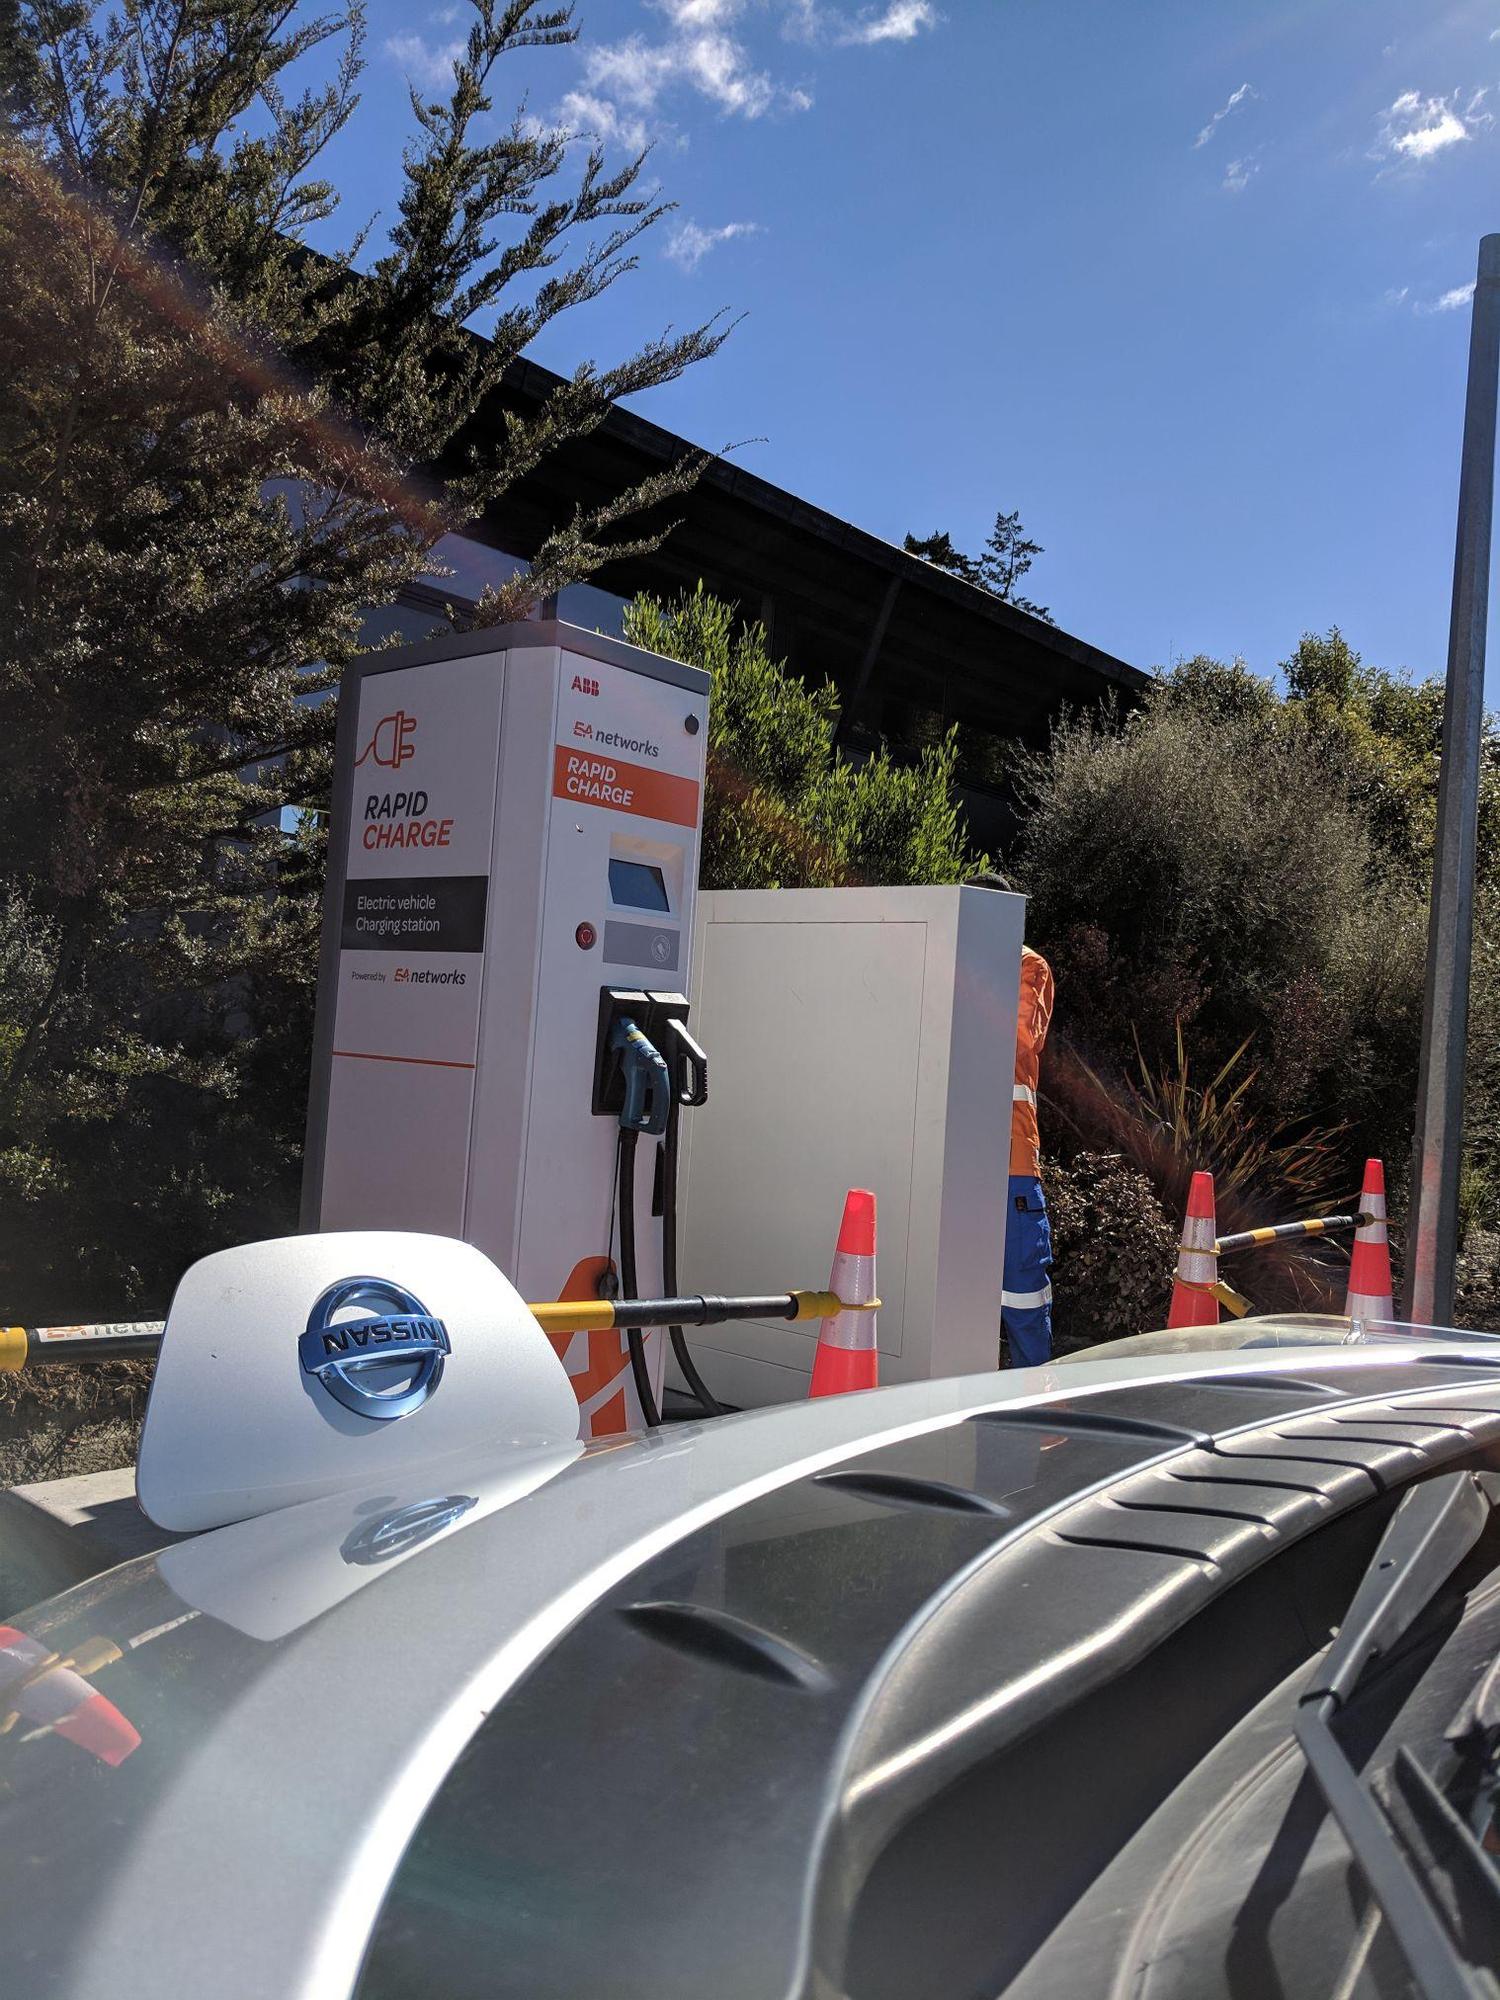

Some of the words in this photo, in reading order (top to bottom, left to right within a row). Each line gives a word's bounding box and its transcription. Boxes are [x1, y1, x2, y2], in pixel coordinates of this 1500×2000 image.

[571, 675, 600, 697] ABB
[573, 720, 593, 740] EA
[595, 730, 660, 758] networks
[567, 756, 617, 782] RAPID
[566, 776, 634, 807] CHARGE
[364, 791, 429, 820] RAPID
[362, 819, 454, 849] CHARGE
[357, 895, 396, 910] Electric
[397, 894, 436, 910] vehicle
[355, 916, 401, 935] Charging
[401, 916, 440, 932] station
[351, 970, 378, 981] Powered
[378, 971, 386, 983] by
[410, 969, 467, 985] networks
[321, 1321, 439, 1356] NISSAN
